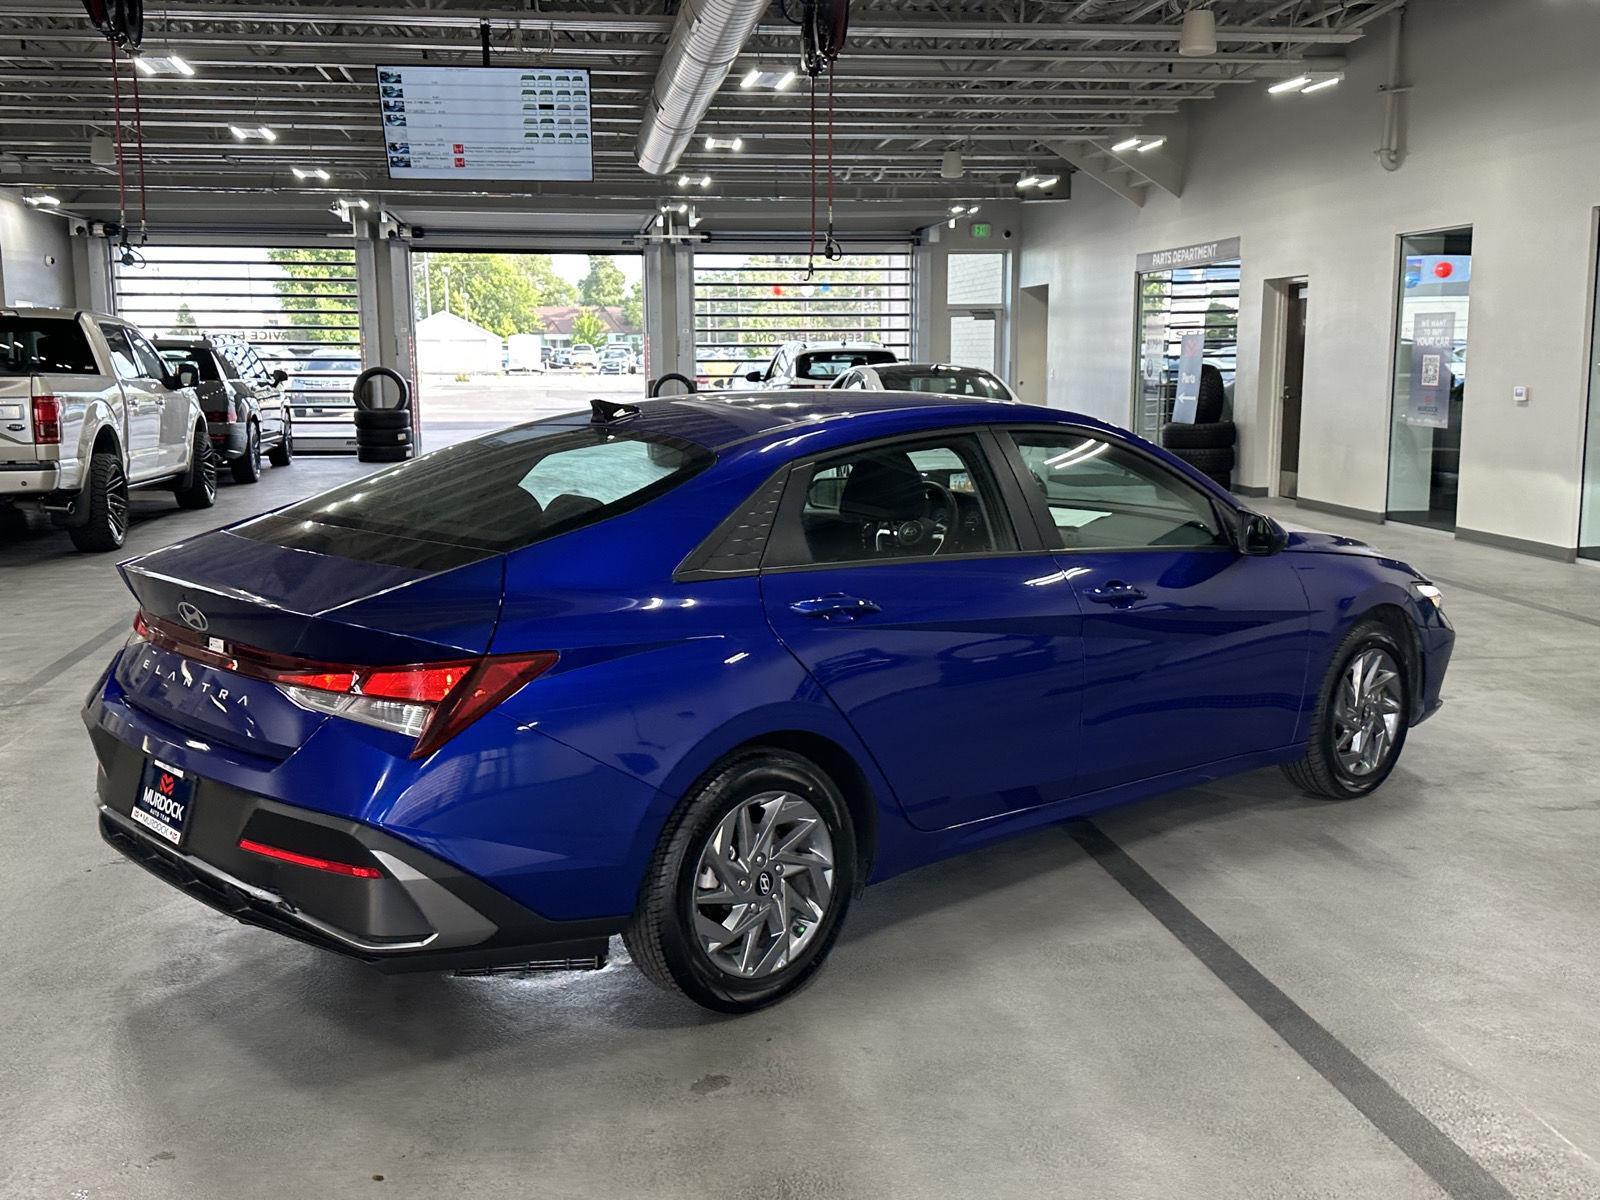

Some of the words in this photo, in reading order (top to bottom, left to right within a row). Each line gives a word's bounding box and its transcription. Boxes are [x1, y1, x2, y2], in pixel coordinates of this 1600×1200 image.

[1152, 252, 1172, 266] PARTS
[1172, 243, 1218, 264] DEPARTMENT
[1431, 319, 1447, 327] WANT
[1416, 336, 1434, 346] YOUR
[1435, 336, 1450, 346] CAR
[142, 660, 248, 706] ELANTRA
[143, 786, 184, 821] MURDOCK
[142, 814, 169, 836] MURDOCK
[149, 808, 160, 818] AUTO
[160, 812, 171, 823] TEAM
